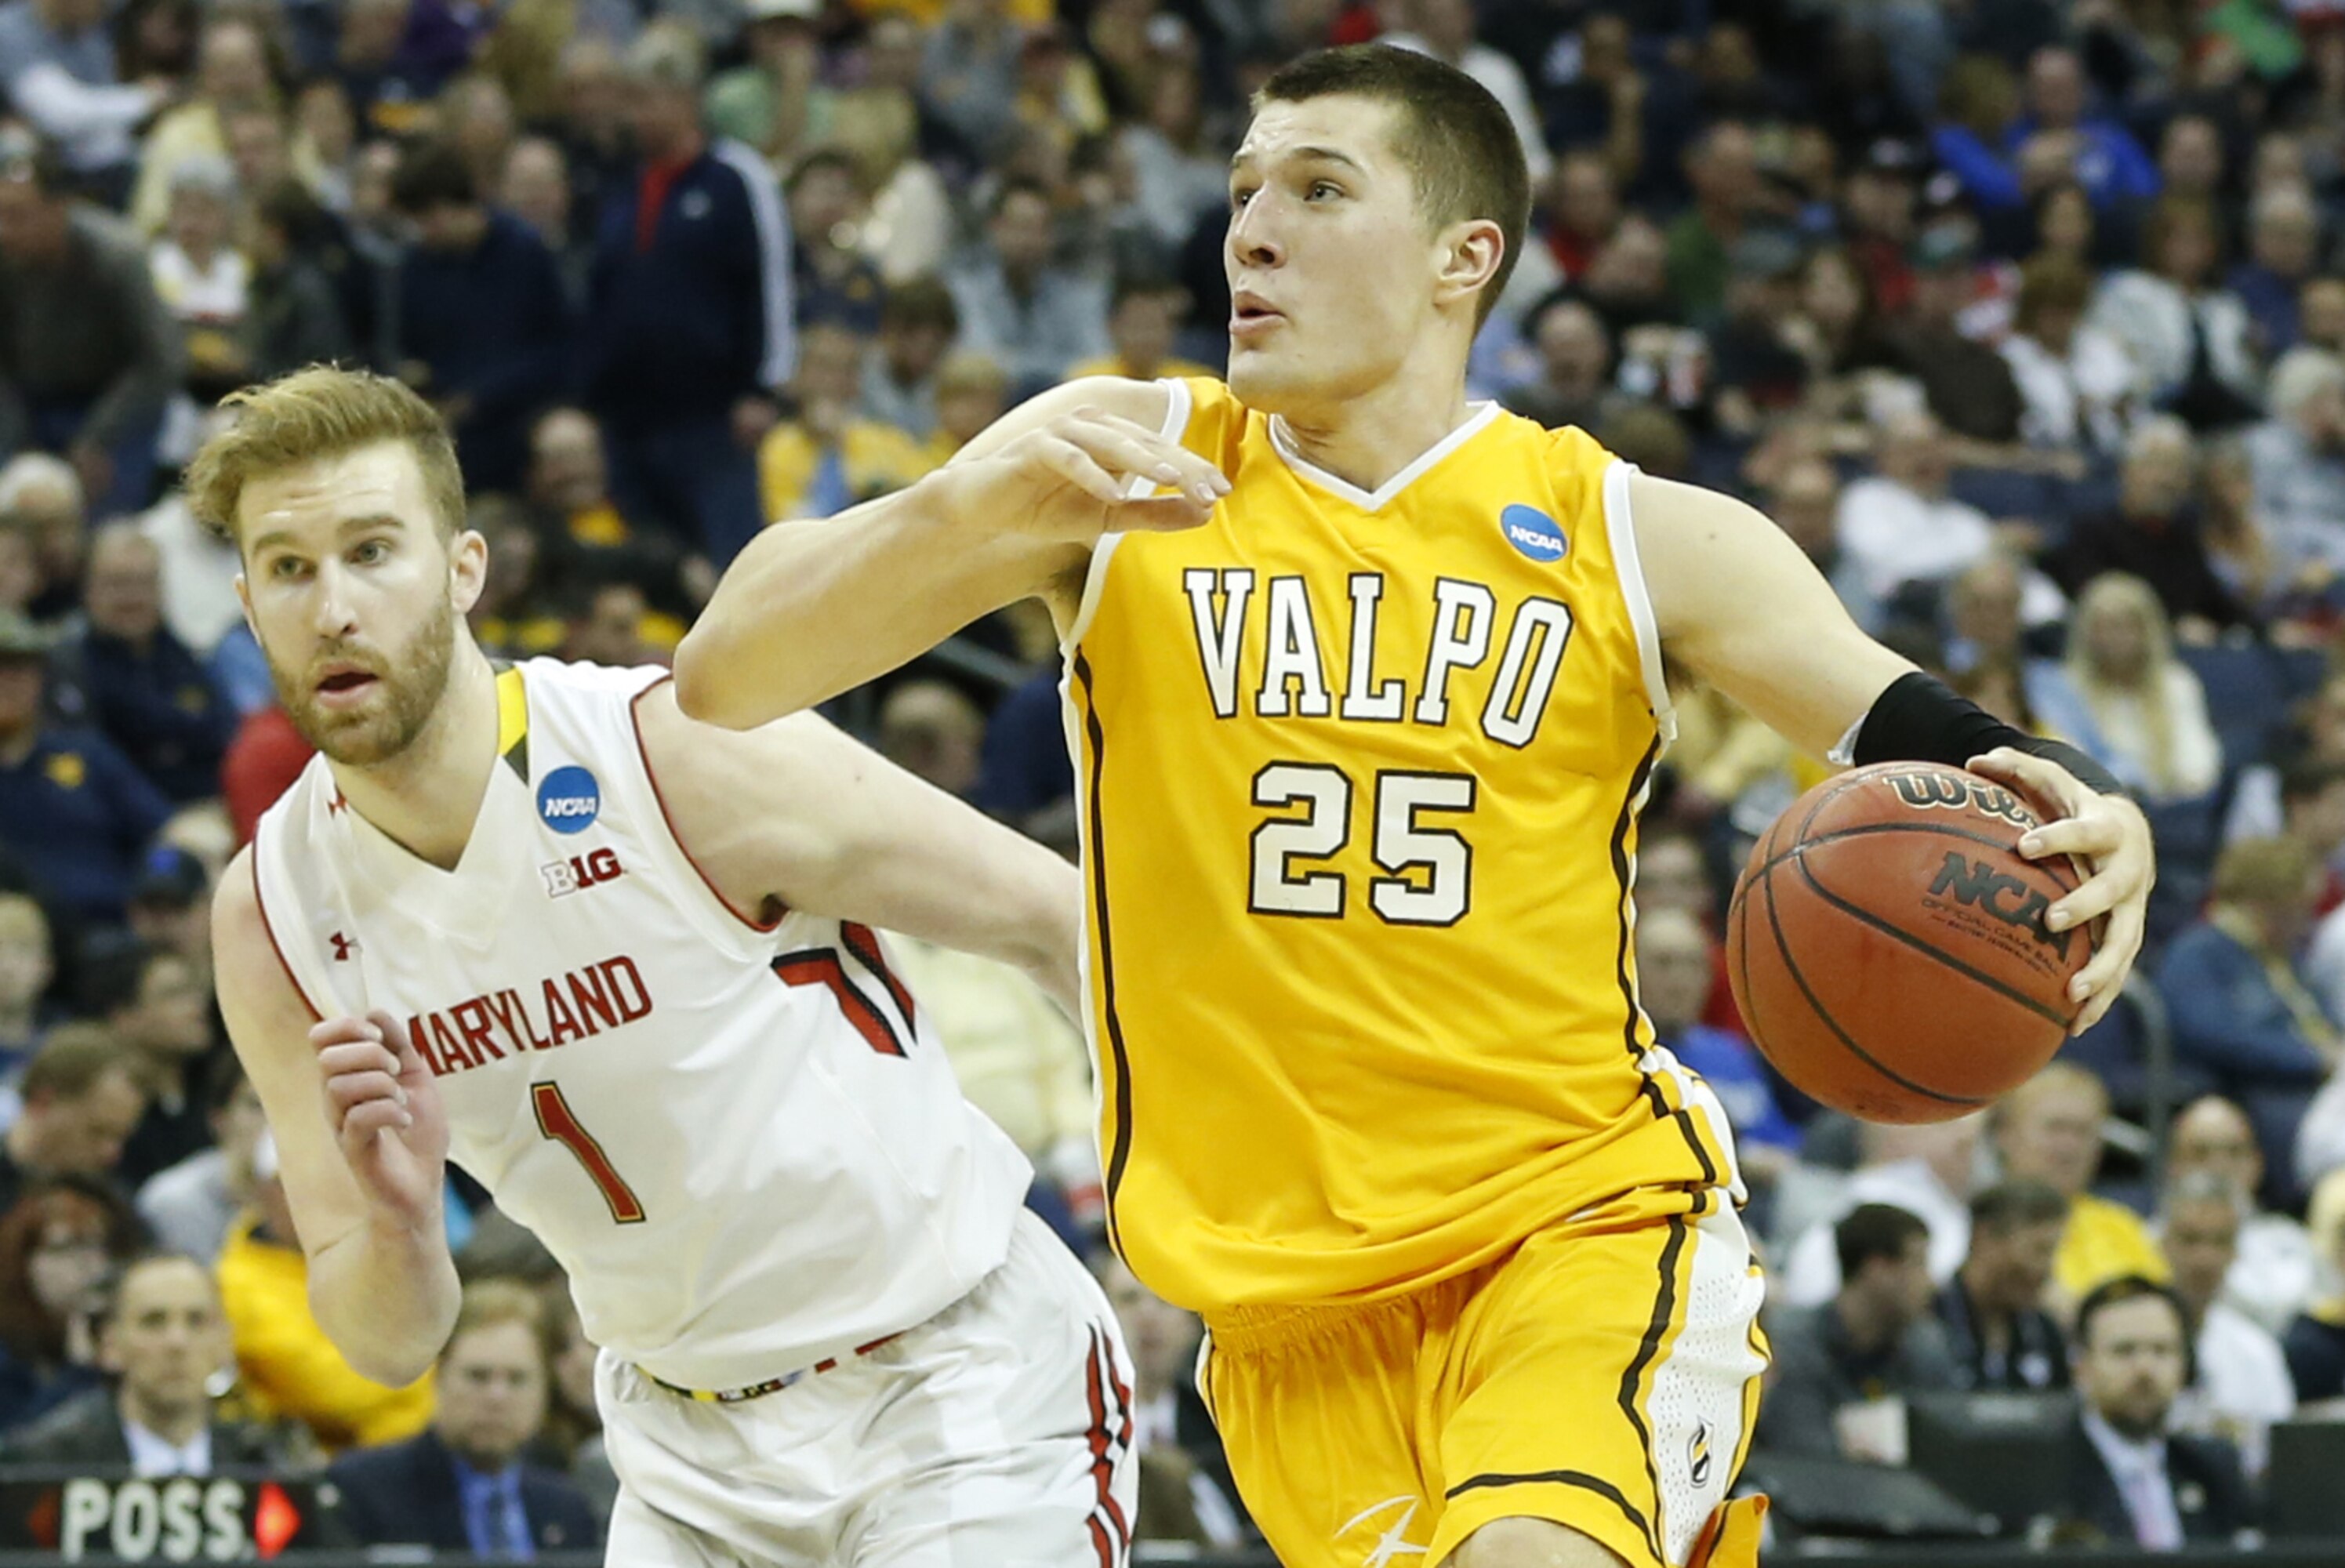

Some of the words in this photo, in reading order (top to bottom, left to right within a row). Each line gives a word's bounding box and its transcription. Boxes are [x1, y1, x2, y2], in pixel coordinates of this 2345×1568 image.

[1510, 524, 1563, 553] NCAA
[1183, 568, 1574, 749] VALPO
[544, 797, 597, 818] NCAA
[1247, 760, 1476, 927] 25
[530, 1080, 647, 1224] 1
